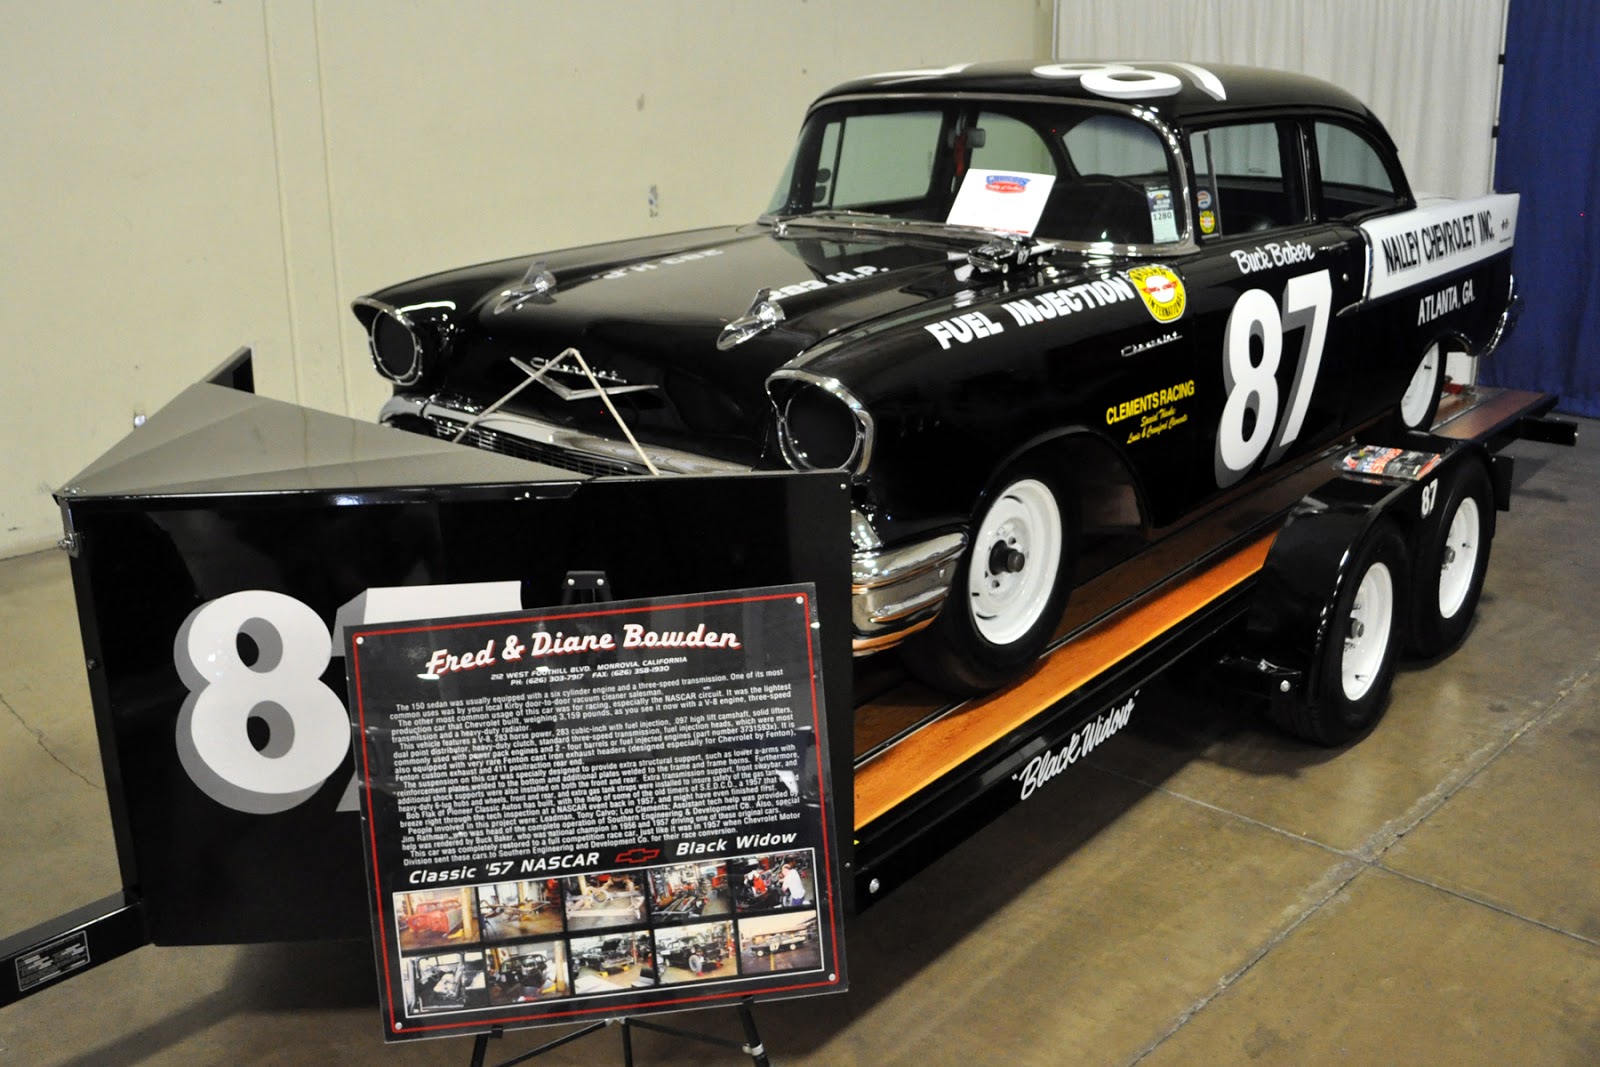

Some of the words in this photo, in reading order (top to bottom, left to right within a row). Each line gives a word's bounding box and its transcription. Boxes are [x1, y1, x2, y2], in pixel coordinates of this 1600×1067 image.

[1152, 211, 1173, 221] 1280
[1017, 250, 1030, 265] 87
[1230, 247, 1272, 274] Buck
[1264, 241, 1315, 267] Baker
[1381, 230, 1421, 276] NALLEY
[1421, 214, 1476, 262] CHEVROLET
[1477, 210, 1495, 246] INC.
[826, 265, 890, 284] H.P.
[924, 311, 1004, 350] FUEL
[1002, 276, 1135, 327] INJECTION
[1417, 286, 1461, 327] ATLANTA,
[1462, 279, 1476, 305] GA.
[1215, 268, 1333, 487] 87
[1105, 391, 1160, 425] CLEMENTS
[1159, 379, 1195, 406] RACING
[1421, 478, 1438, 519] 87
[424, 639, 497, 677] Fred
[501, 634, 527, 662] &
[531, 631, 616, 657] Diane
[622, 623, 743, 651] Bowden
[530, 667, 567, 676] FOOTHILL
[641, 656, 687, 666] CALIFORNIA
[411, 702, 425, 710] 150
[426, 700, 448, 708] sedan
[465, 696, 491, 706] usually
[492, 693, 525, 704] equipped
[526, 691, 542, 699] with
[561, 687, 591, 697] cylinder
[592, 685, 616, 694] engine
[616, 683, 631, 691] and
[637, 679, 680, 690] three-speed
[765, 669, 783, 677] most
[525, 676, 547, 684] (626)
[610, 668, 632, 676] (626)
[389, 712, 420, 720] common
[456, 706, 466, 715] by
[467, 706, 484, 714] your
[485, 703, 503, 711] local
[504, 701, 523, 711] Kirby
[572, 695, 600, 703] vacuum
[601, 691, 627, 700] cleaner
[391, 725, 432, 737] production
[447, 722, 463, 730] that
[464, 719, 500, 728] Chevrolet
[523, 713, 557, 724] weighing
[624, 707, 639, 715] you
[679, 700, 696, 708] with
[747, 691, 791, 703] three-speed
[398, 719, 412, 727] The
[413, 717, 434, 725] other
[435, 715, 455, 723] most
[456, 713, 489, 721] common
[491, 711, 514, 720] usage
[525, 707, 539, 715] this
[612, 697, 649, 708] especially
[664, 693, 696, 702] NASCAR
[749, 686, 762, 694] the
[763, 684, 791, 694] lightest
[391, 733, 438, 743] transmission
[438, 731, 453, 739] and
[403, 857, 432, 866] Division
[433, 855, 449, 863] sent
[450, 853, 470, 861] these
[498, 847, 530, 856] Southern
[531, 842, 574, 854] Engineering
[590, 836, 636, 848] Development
[662, 832, 680, 840] their
[410, 849, 426, 857] This
[457, 842, 498, 854] completely
[498, 839, 530, 848] restored
[561, 831, 605, 843] competition
[722, 817, 742, 825] when
[743, 814, 777, 823] Chevrolet
[778, 812, 800, 820] Motor
[408, 864, 477, 883] Classic
[485, 860, 515, 876] '57
[519, 851, 600, 872] NASCAR
[675, 838, 728, 856] Black
[736, 831, 797, 850] Widow
